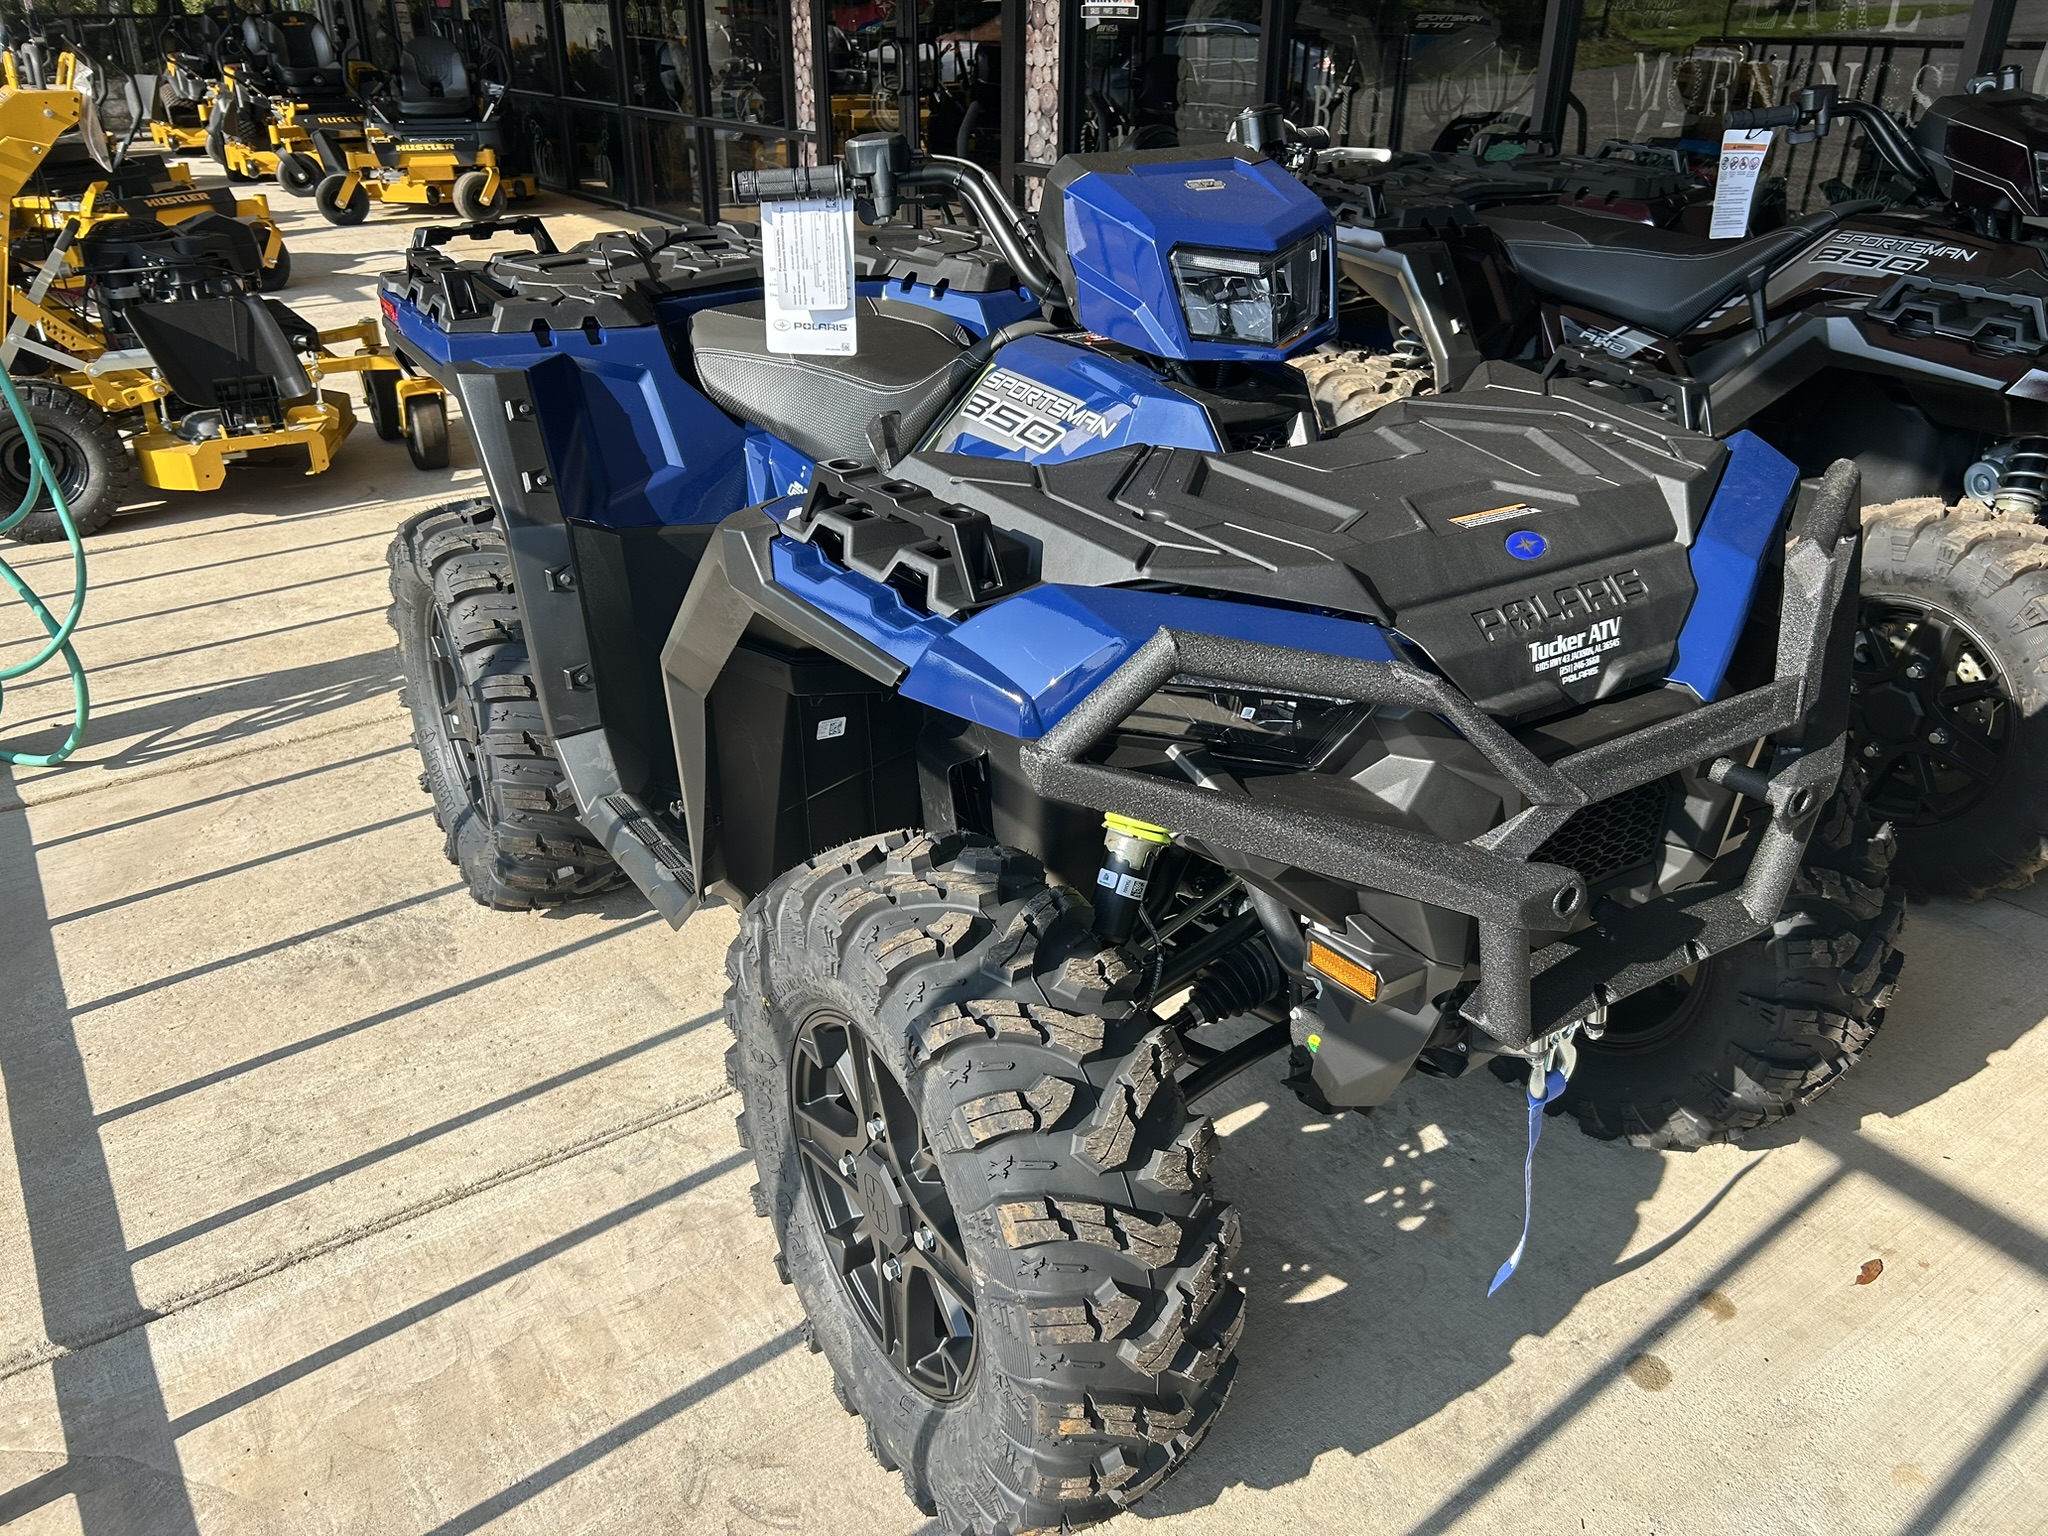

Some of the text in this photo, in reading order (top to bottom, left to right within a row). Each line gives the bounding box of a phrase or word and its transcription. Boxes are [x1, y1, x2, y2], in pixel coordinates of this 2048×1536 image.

[1415, 13, 1483, 23] SPORTSMAN
[1416, 21, 1454, 29] 570
[1313, 84, 1384, 138] BIG
[395, 142, 455, 152] HUSTLER
[143, 191, 211, 208] HUSTLER
[1832, 233, 1978, 262] SPORTSMAN
[794, 322, 849, 332] POLARIS
[981, 371, 1119, 440] SPORTSMAN
[1471, 568, 1649, 642] POLARIS
[1528, 616, 1622, 663] Tucker ATV
[1561, 666, 1599, 686] POLARIS
